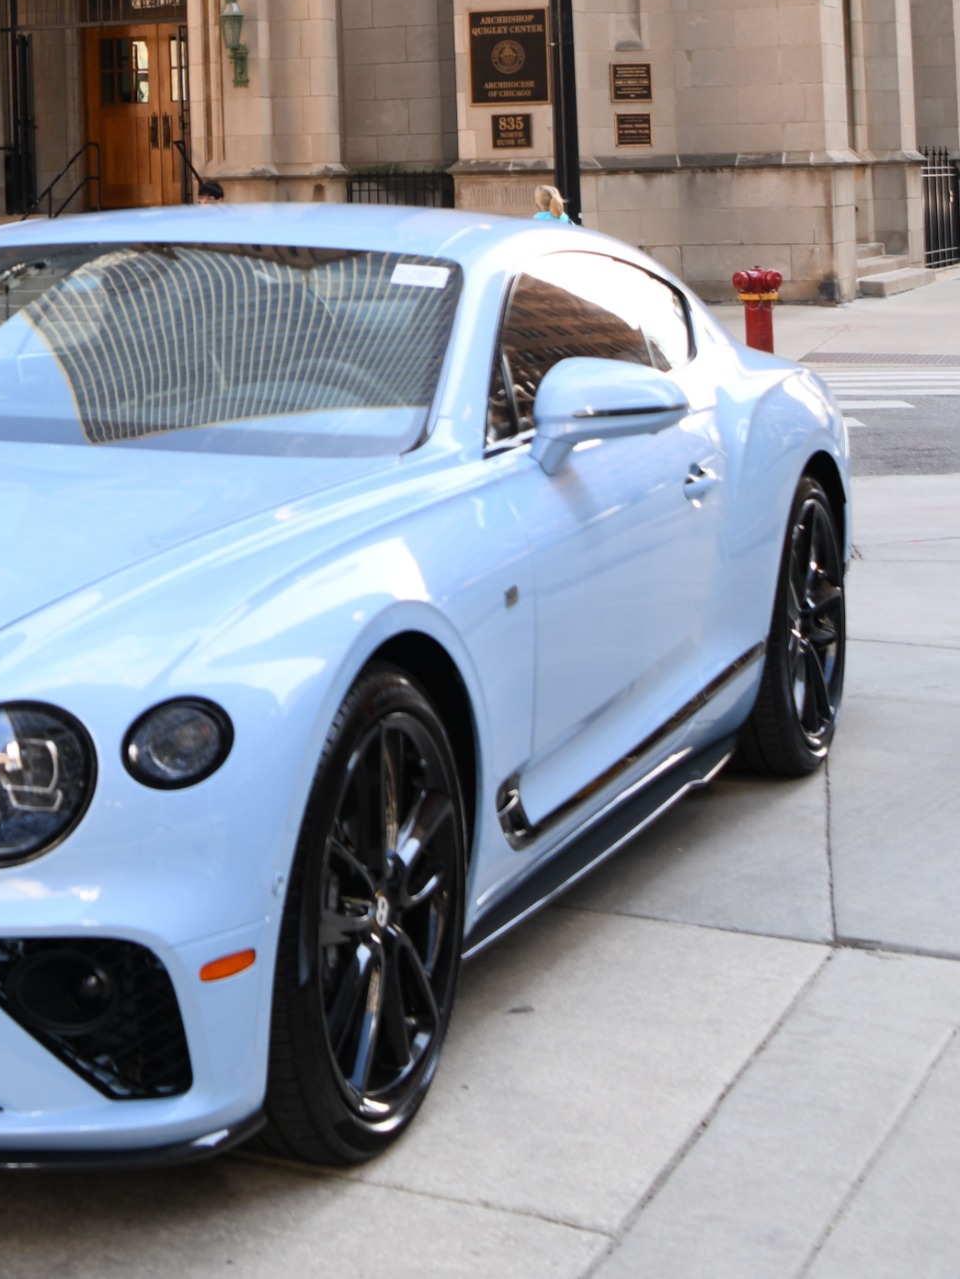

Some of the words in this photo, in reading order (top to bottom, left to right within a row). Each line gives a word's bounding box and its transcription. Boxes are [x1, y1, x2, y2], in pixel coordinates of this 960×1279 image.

[480, 15, 534, 24] ARCHBISHOP
[471, 26, 508, 36] QUIGLEY
[509, 25, 543, 33] CENTER
[498, 117, 523, 130] 835
